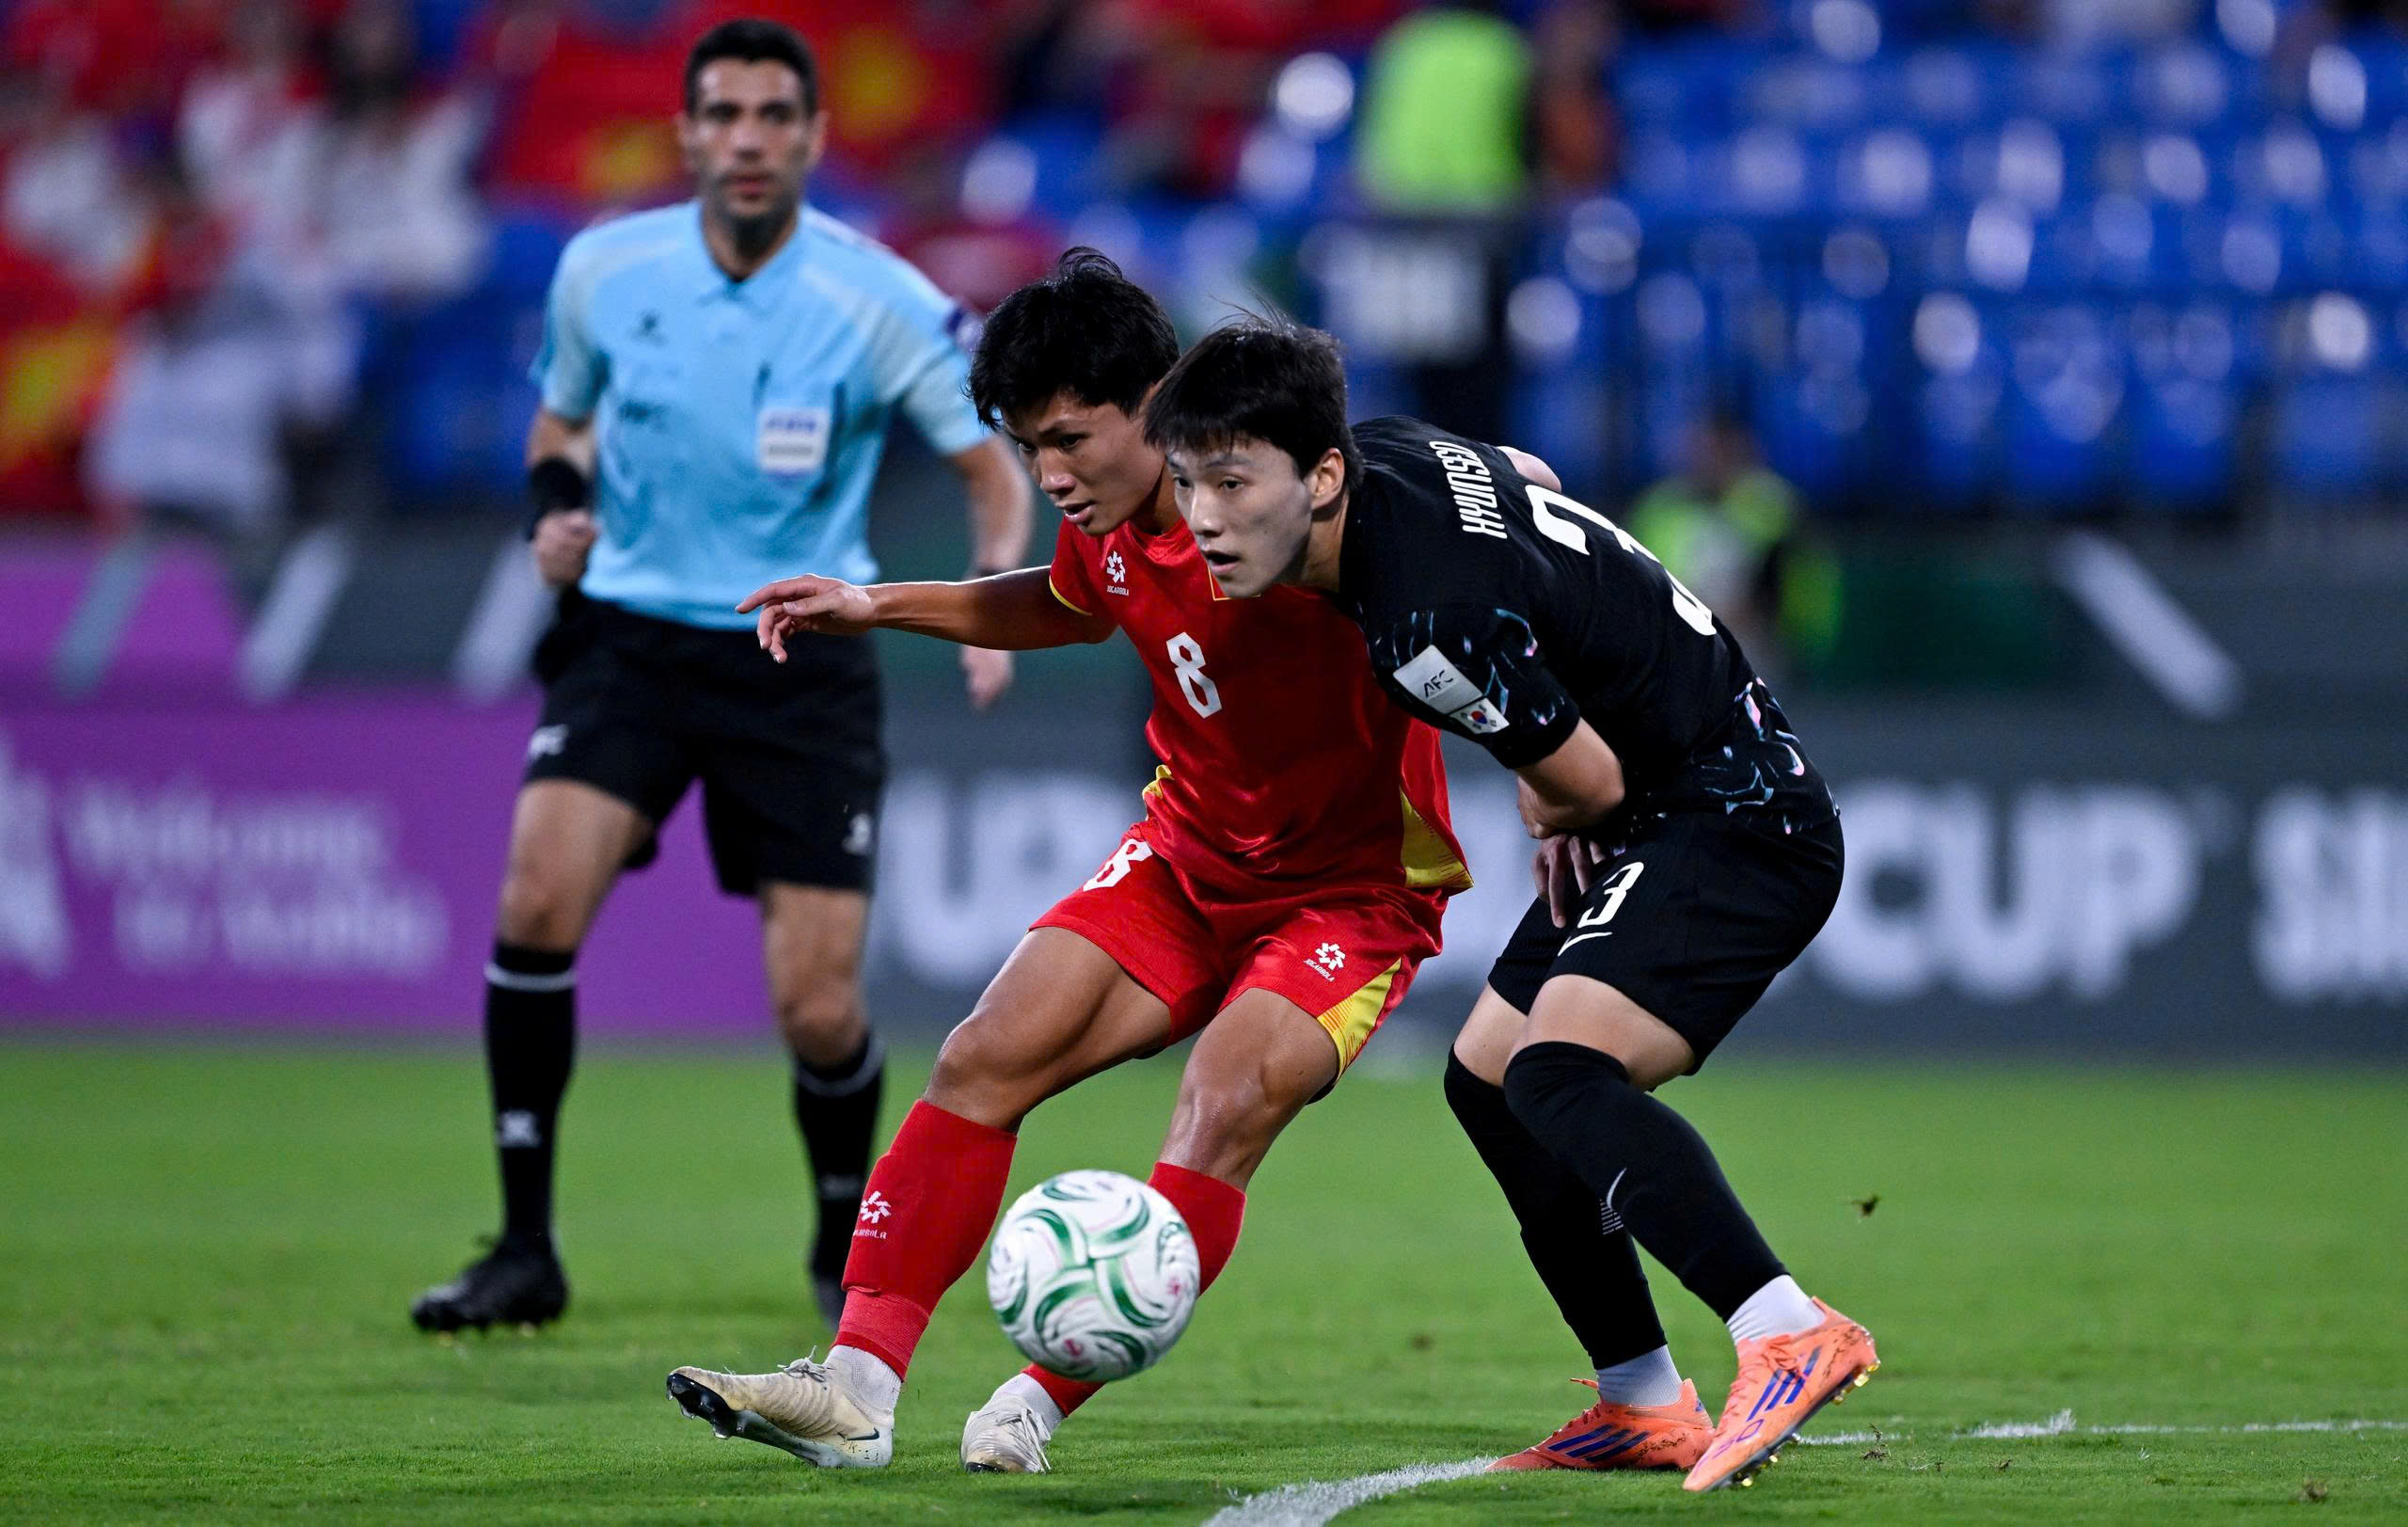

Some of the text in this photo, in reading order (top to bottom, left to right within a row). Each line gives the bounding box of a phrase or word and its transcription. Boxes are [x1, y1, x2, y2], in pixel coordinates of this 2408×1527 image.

[1165, 631, 1222, 719] 8
[1423, 669, 1454, 698] AFC
[1083, 837, 1153, 892] 8
[1576, 861, 1645, 929] 3
[1814, 781, 2199, 1001] CUP
